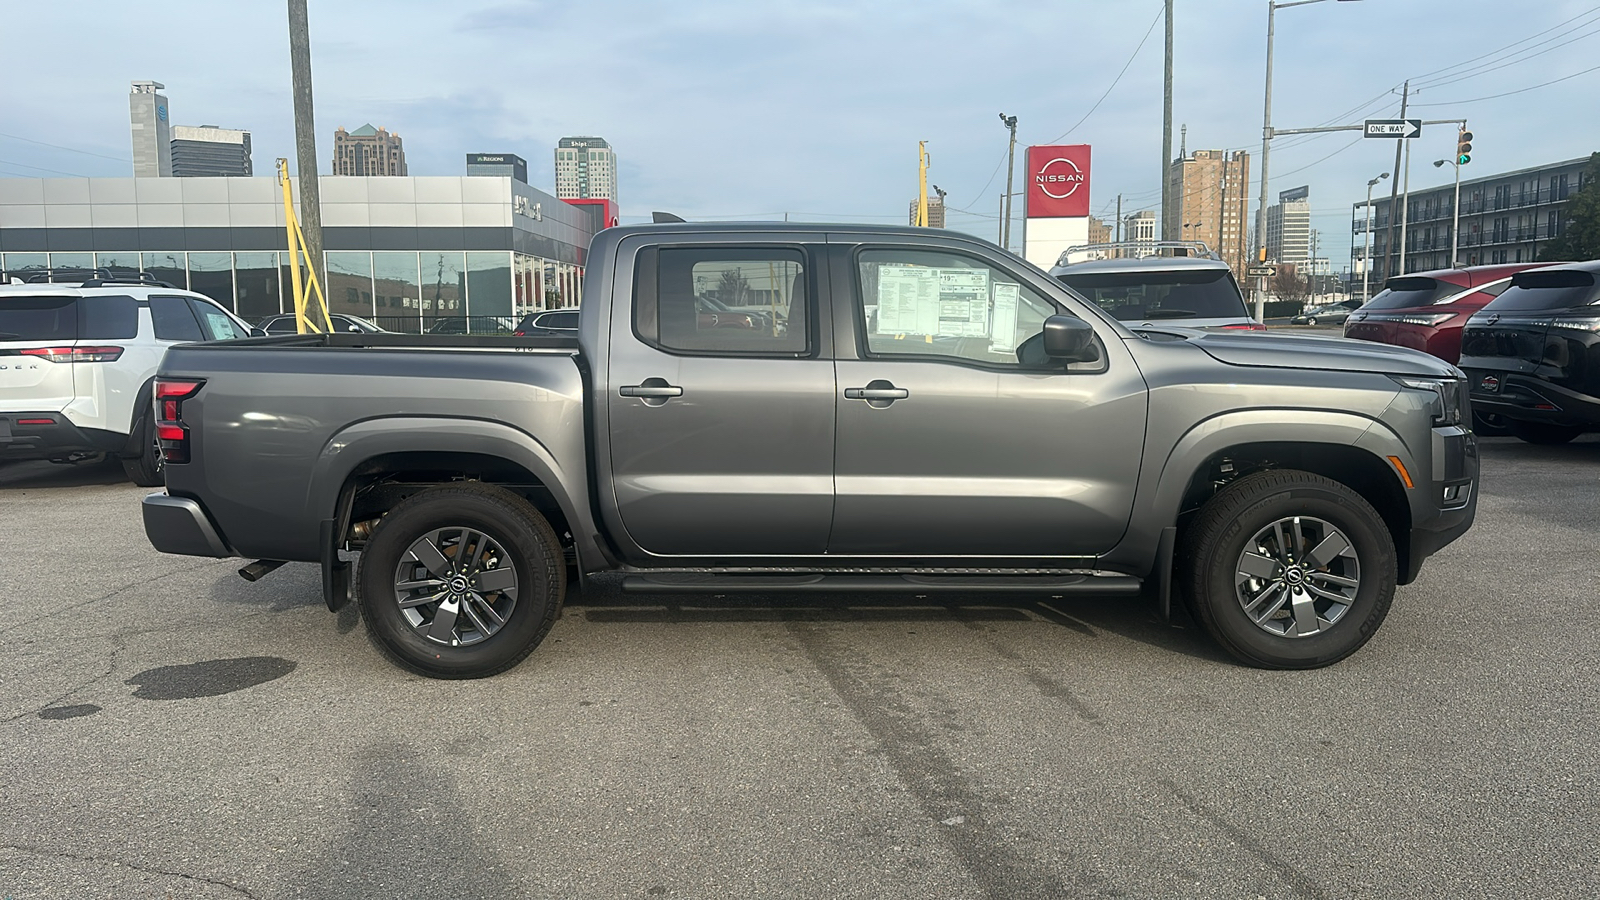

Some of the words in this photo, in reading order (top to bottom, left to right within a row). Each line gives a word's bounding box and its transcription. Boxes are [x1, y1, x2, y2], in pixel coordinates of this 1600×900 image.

[1370, 125, 1386, 133] ONE
[1388, 125, 1405, 133] WAY
[1035, 174, 1084, 182] NISSAN
